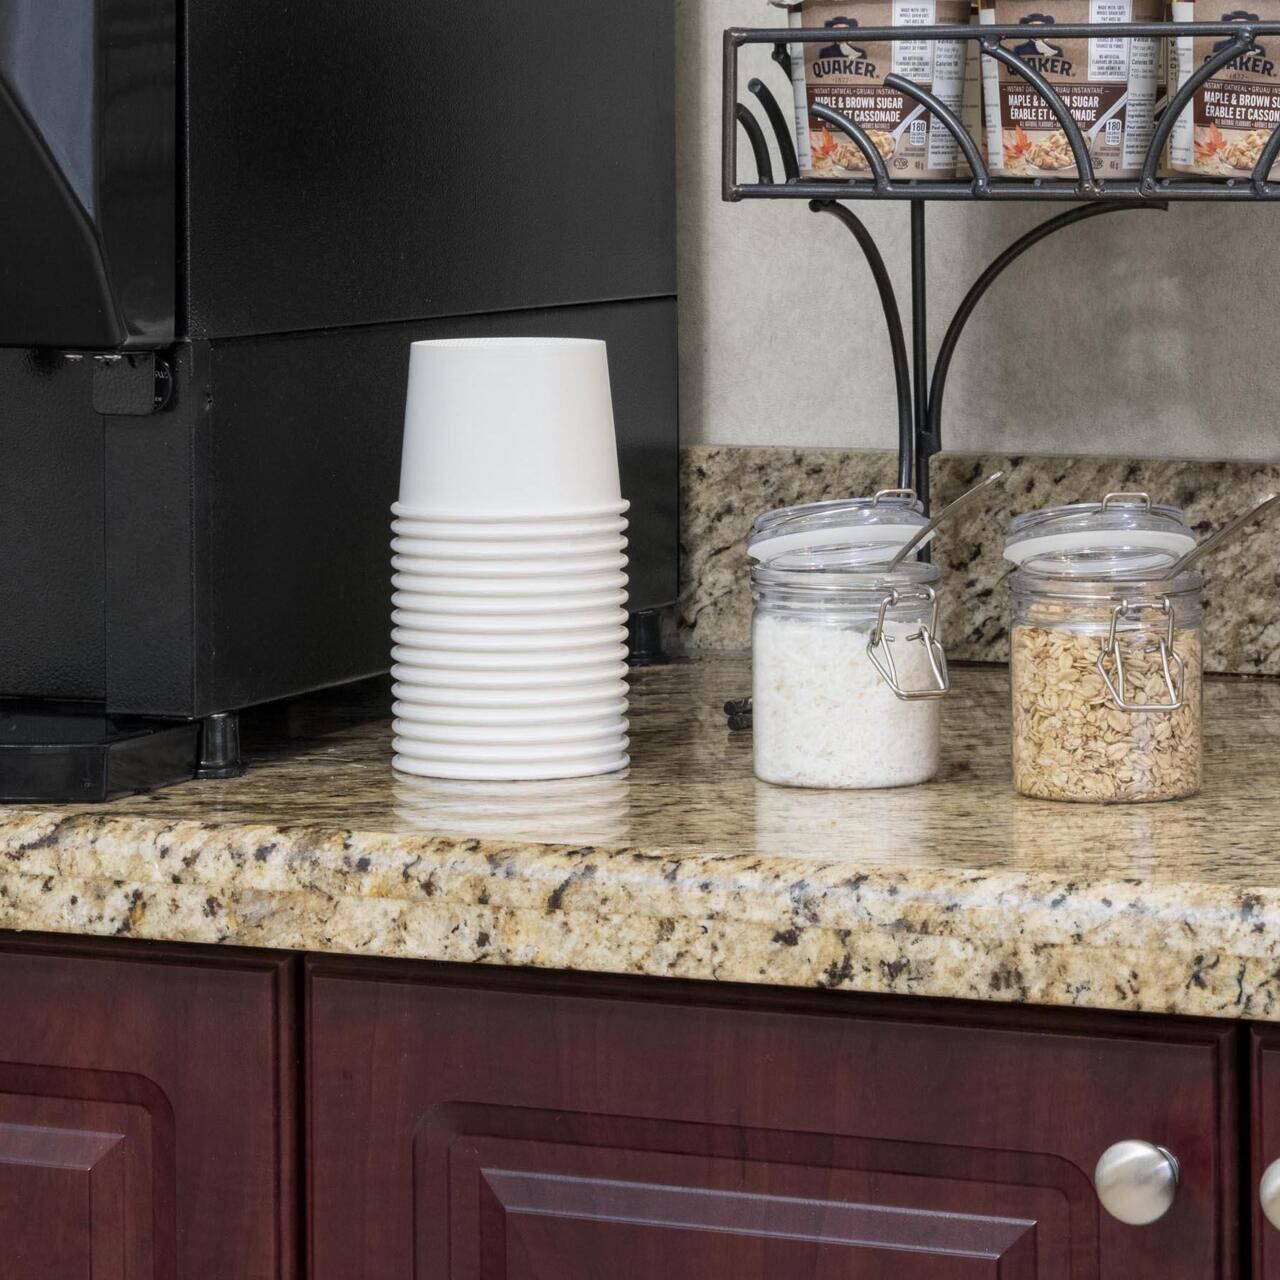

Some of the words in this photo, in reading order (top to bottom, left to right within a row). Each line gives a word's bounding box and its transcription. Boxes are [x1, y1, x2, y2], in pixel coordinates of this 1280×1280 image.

[813, 60, 876, 78] QUAKER
[838, 97, 844, 108] &
[846, 97, 874, 108] BROWN
[876, 97, 903, 109] SUGAR
[1009, 94, 1031, 106] MAPLE
[1033, 95, 1039, 106] &
[1072, 96, 1099, 108] SUGAR
[1204, 91, 1229, 103] MAPLE
[1232, 94, 1237, 104] &
[1240, 94, 1270, 107] BROWN
[854, 110, 900, 122] CASSONADE
[1011, 107, 1036, 120] ÉRABLE
[1039, 109, 1048, 120] ET
[1206, 102, 1234, 117] ÉRABLE
[1236, 108, 1245, 118] ET
[912, 122, 925, 131] 180
[1108, 121, 1120, 130] 180
